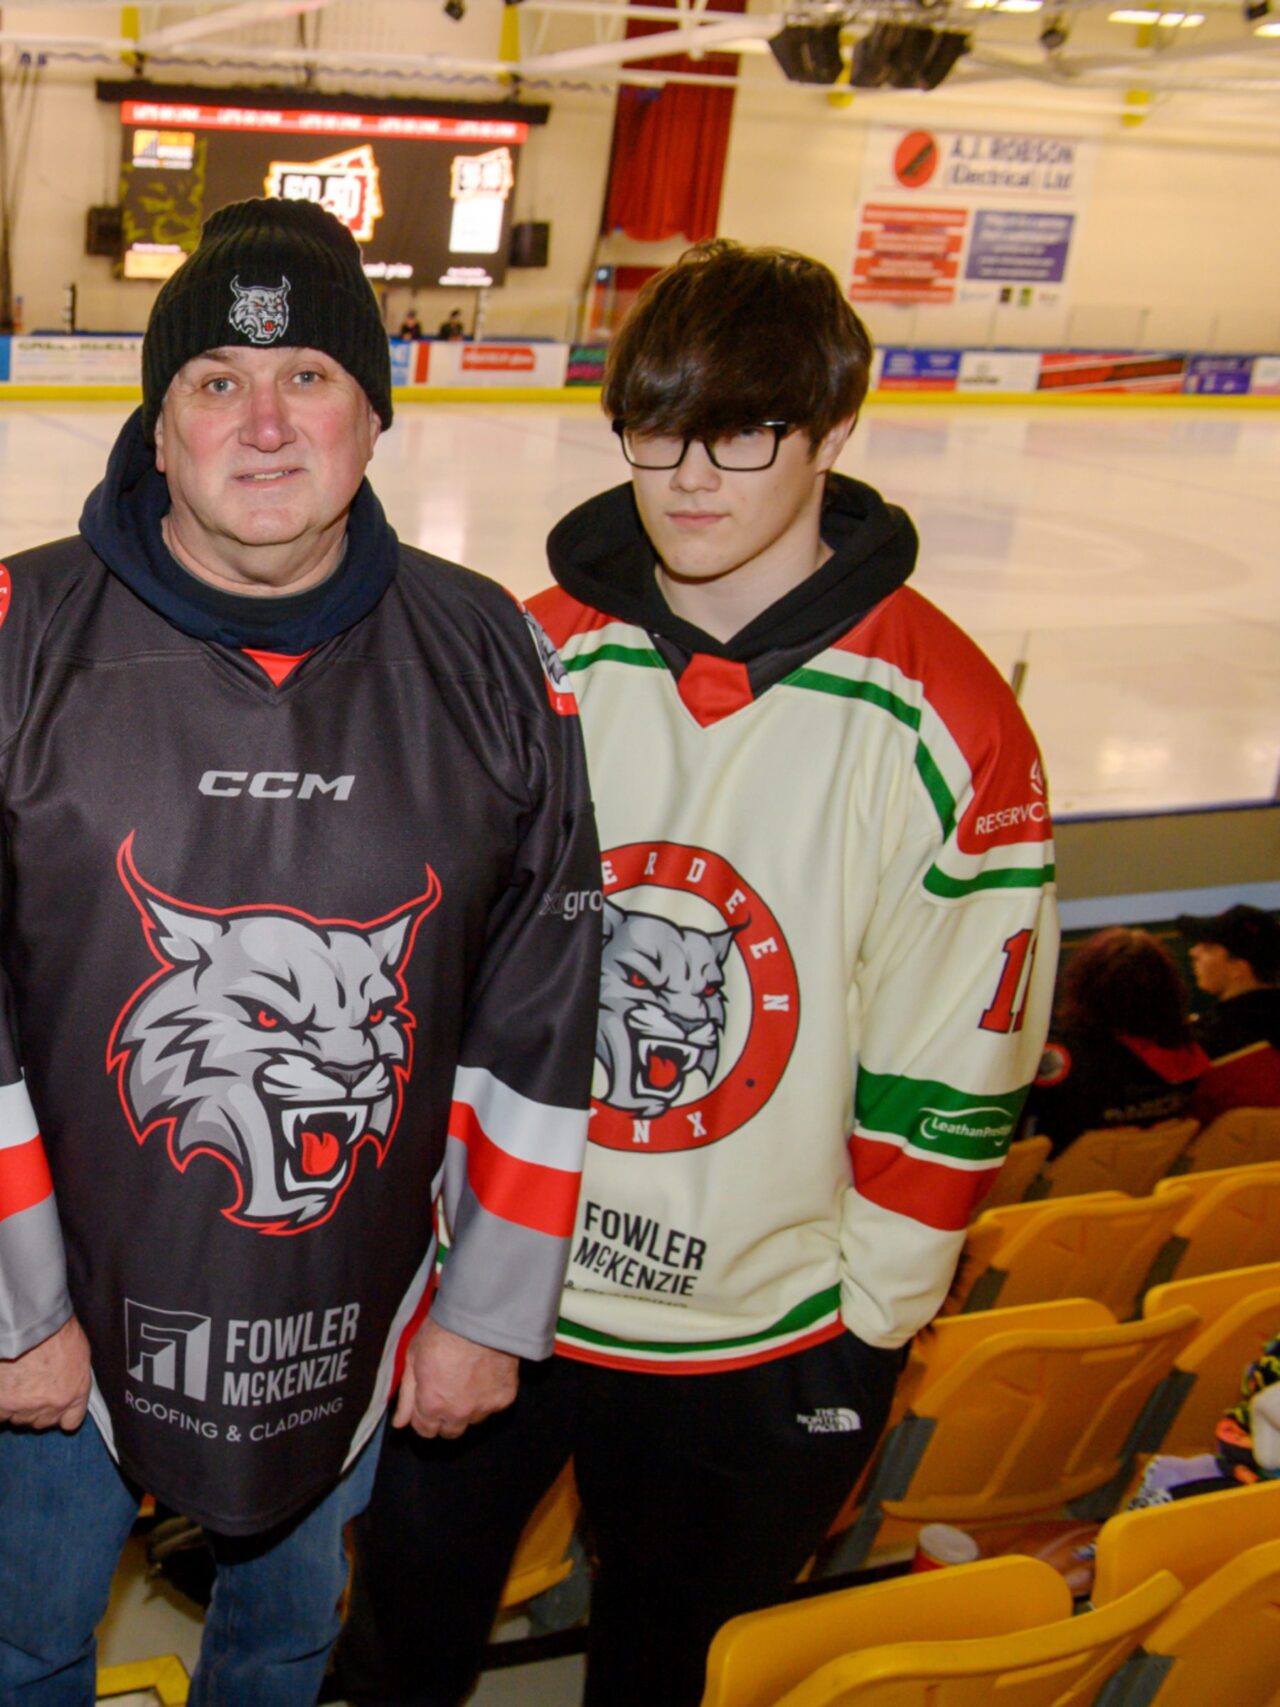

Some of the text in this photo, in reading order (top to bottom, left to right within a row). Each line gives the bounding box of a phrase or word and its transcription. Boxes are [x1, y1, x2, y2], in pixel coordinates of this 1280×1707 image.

[197, 769, 356, 801] CCM
[974, 801, 1048, 836] RESERVO
[601, 852, 790, 1012] ERDEEN
[584, 1200, 707, 1271] FOWLER
[225, 1302, 361, 1364] FOWLER
[124, 1389, 344, 1442] ROOFING & CLADDING
